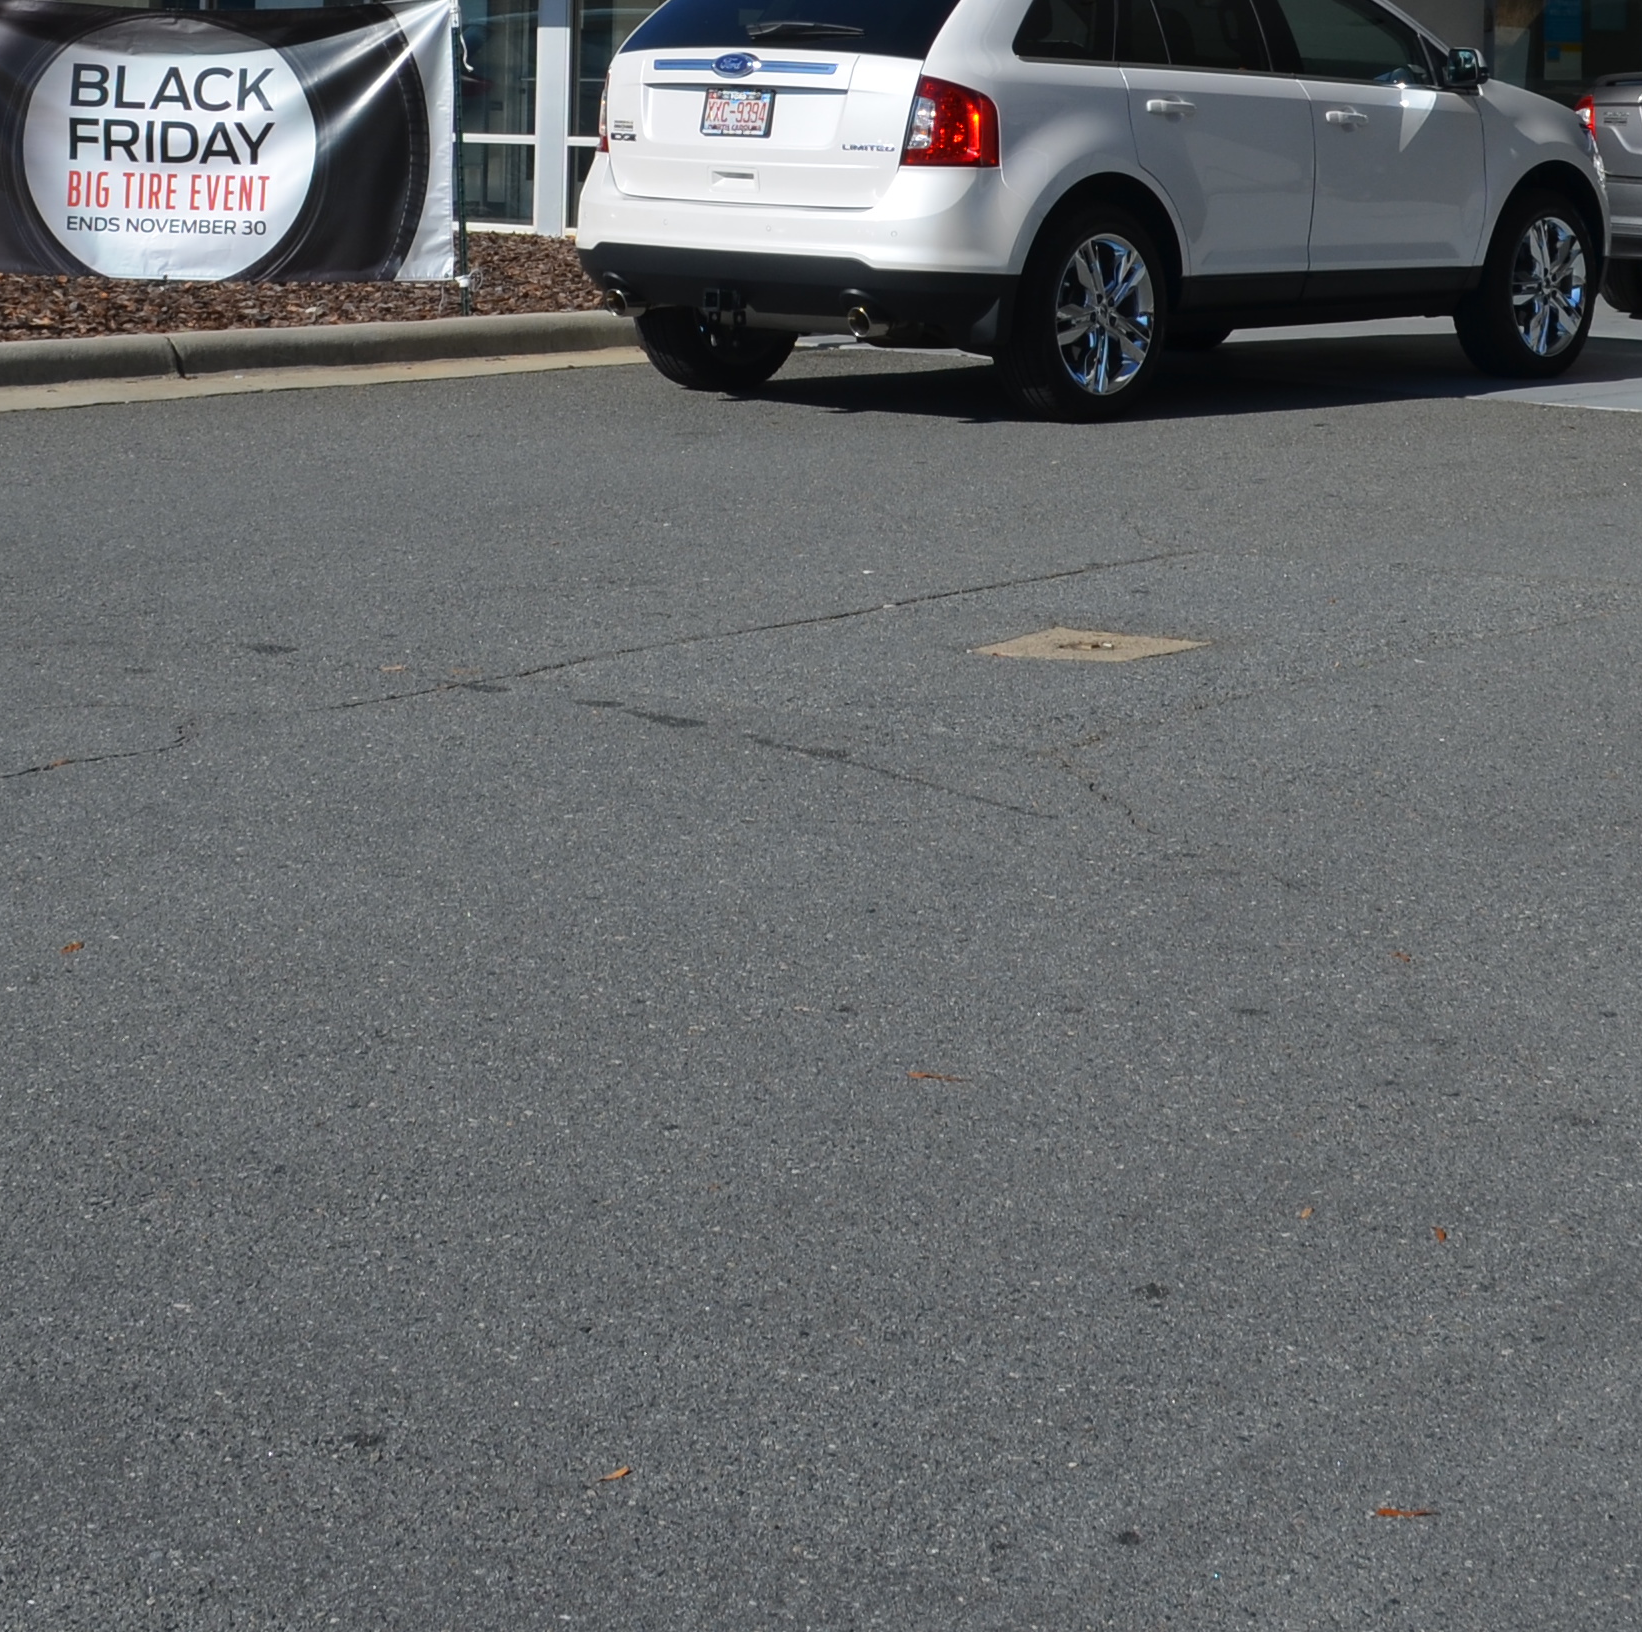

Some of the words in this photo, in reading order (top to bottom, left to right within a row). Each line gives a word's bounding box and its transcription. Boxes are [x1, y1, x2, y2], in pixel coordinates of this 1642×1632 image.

[70, 63, 275, 111] BLACK
[706, 101, 767, 123] XXC-9394
[69, 117, 275, 165] FRIDAY
[842, 143, 895, 152] LIMITED
[67, 170, 109, 208] BIG
[123, 172, 177, 210] TIRE
[189, 174, 270, 211] EVENT
[66, 216, 120, 232] ENDS
[125, 218, 236, 235] NOVEMBER
[241, 221, 266, 235] 30
